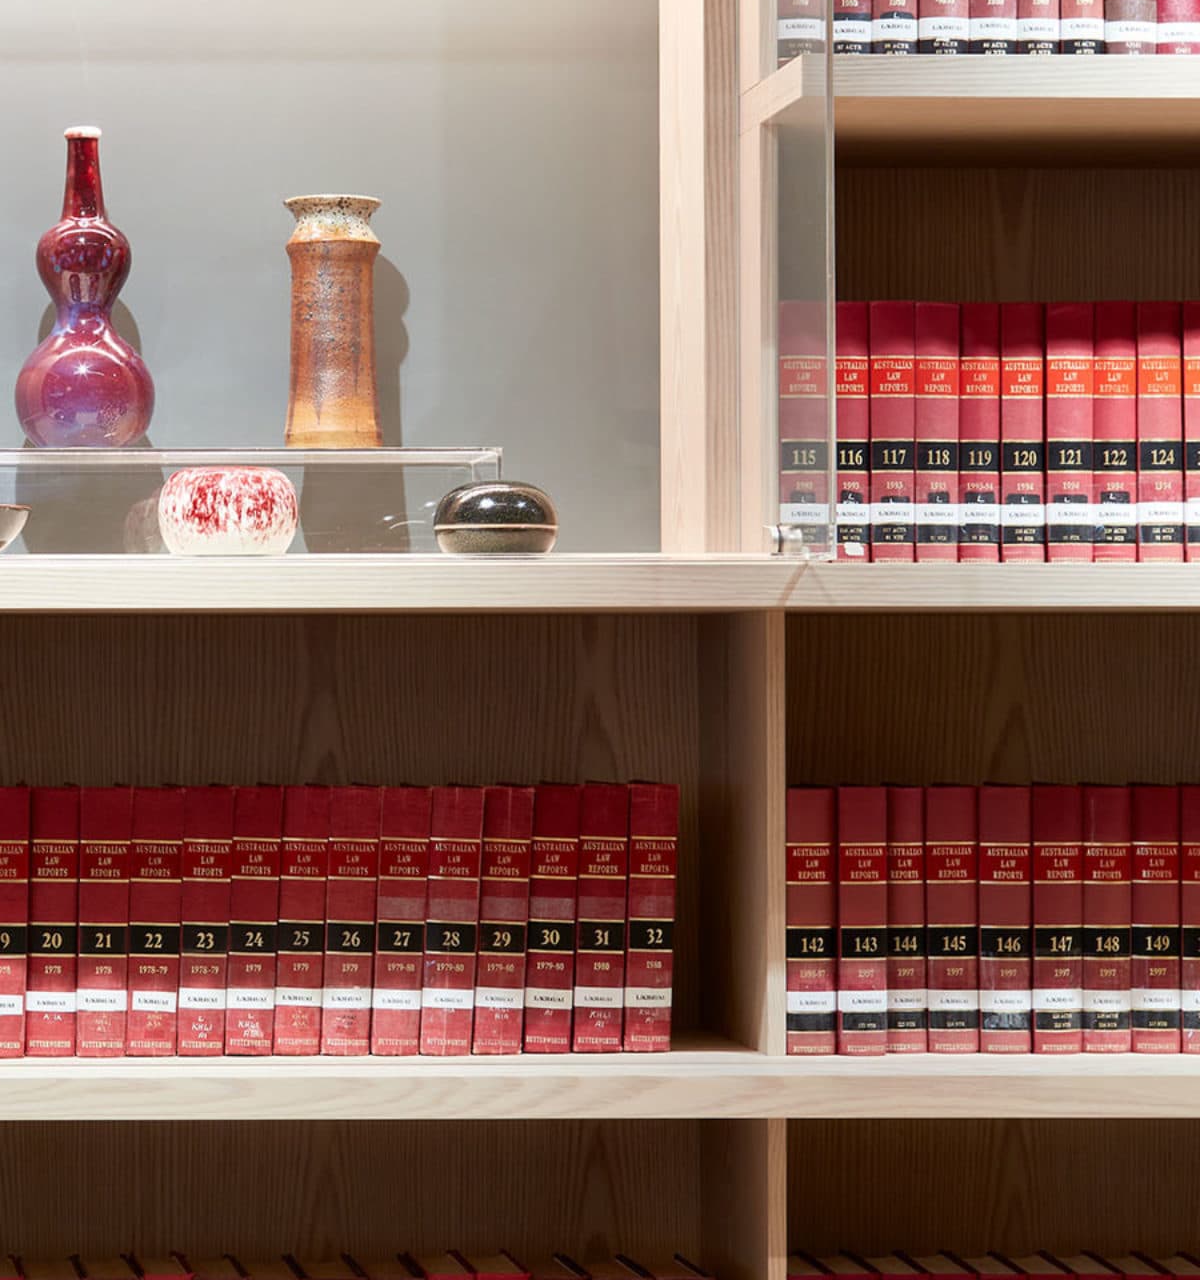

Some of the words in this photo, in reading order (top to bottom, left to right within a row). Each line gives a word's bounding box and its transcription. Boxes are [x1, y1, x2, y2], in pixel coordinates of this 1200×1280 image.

[792, 448, 818, 467] 115
[838, 448, 864, 467] 116
[882, 448, 908, 466] 117
[926, 448, 951, 467] 118
[968, 449, 993, 467] 119
[1012, 449, 1038, 468] 120
[1058, 448, 1084, 466] 121
[1102, 448, 1129, 467] 122
[1149, 448, 1176, 467] 124
[41, 931, 64, 950] 20
[94, 931, 112, 949] 21
[143, 931, 164, 950] 22
[195, 931, 215, 951] 23
[244, 930, 265, 948] 24
[292, 929, 311, 947] 25
[340, 929, 362, 949] 26
[392, 929, 412, 948] 27
[441, 930, 462, 949] 28
[491, 930, 513, 948] 29
[540, 928, 562, 946] 30
[593, 928, 610, 947] 31
[646, 927, 664, 946] 32
[801, 935, 826, 954] 142
[854, 935, 879, 954] 143
[893, 934, 919, 953] 144
[942, 934, 968, 952] 145
[996, 935, 1022, 954] 146
[1049, 934, 1074, 953] 147
[1095, 934, 1121, 954] 148
[1145, 934, 1171, 952] 149
